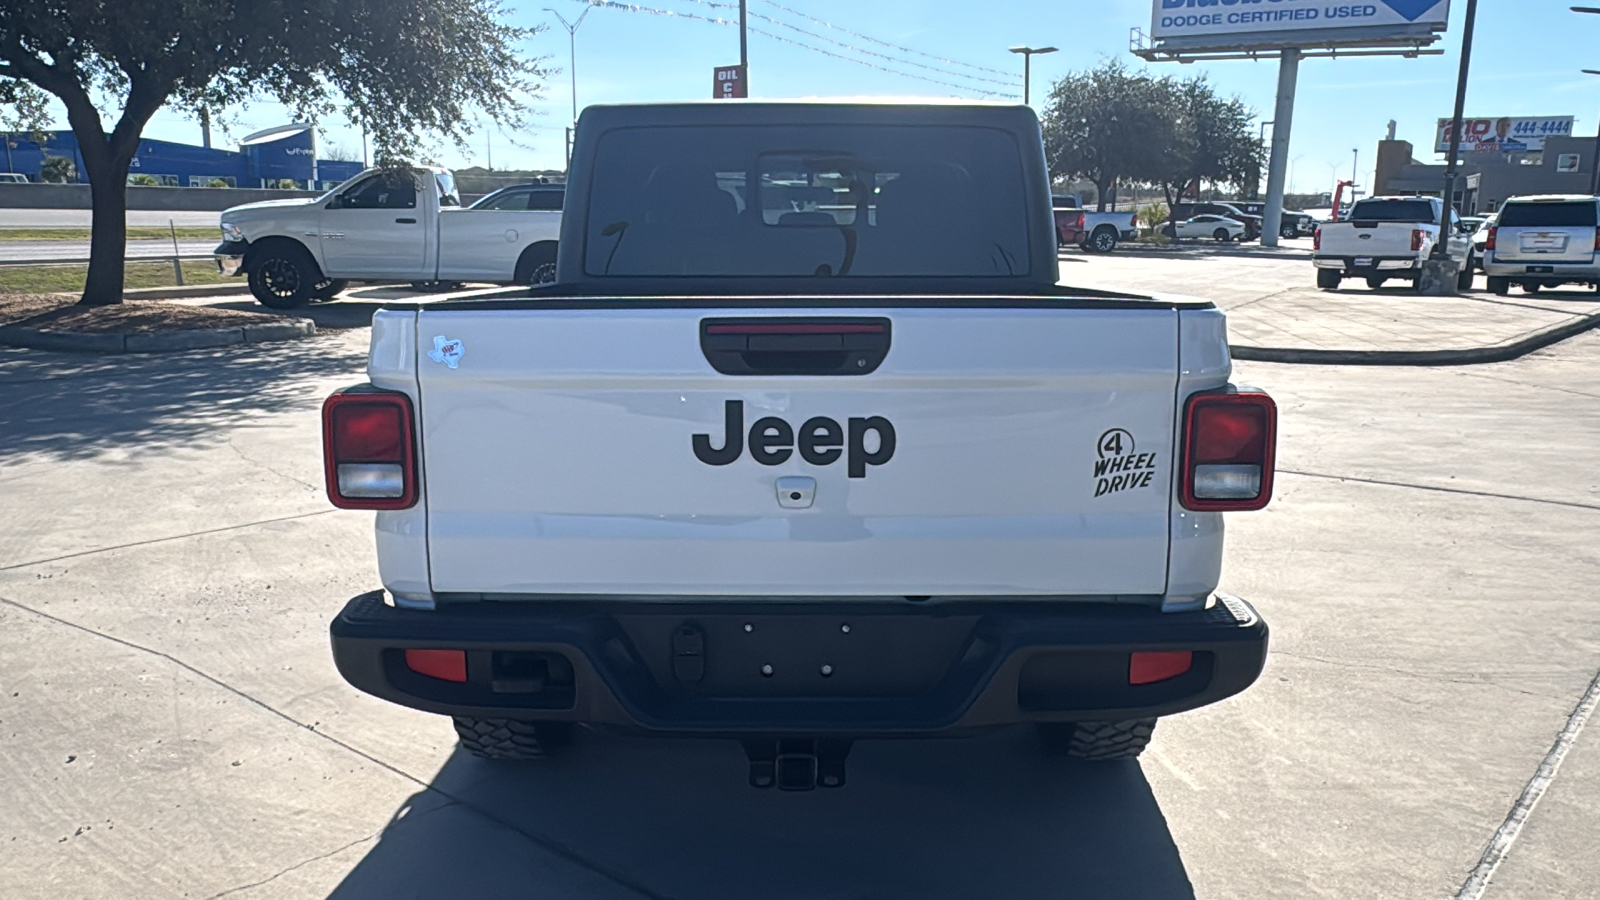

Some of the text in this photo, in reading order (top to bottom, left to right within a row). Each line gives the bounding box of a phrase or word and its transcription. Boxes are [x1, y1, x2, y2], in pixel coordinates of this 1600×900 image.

[1161, 5, 1377, 28] DODGE CERTIFIED USED
[718, 70, 738, 80] OIL
[1514, 121, 1570, 133] 444-4444
[692, 400, 897, 478] Jeep
[1103, 432, 1123, 456] 4
[1093, 452, 1157, 478] WHEEL
[1093, 471, 1156, 498] DRIVE
